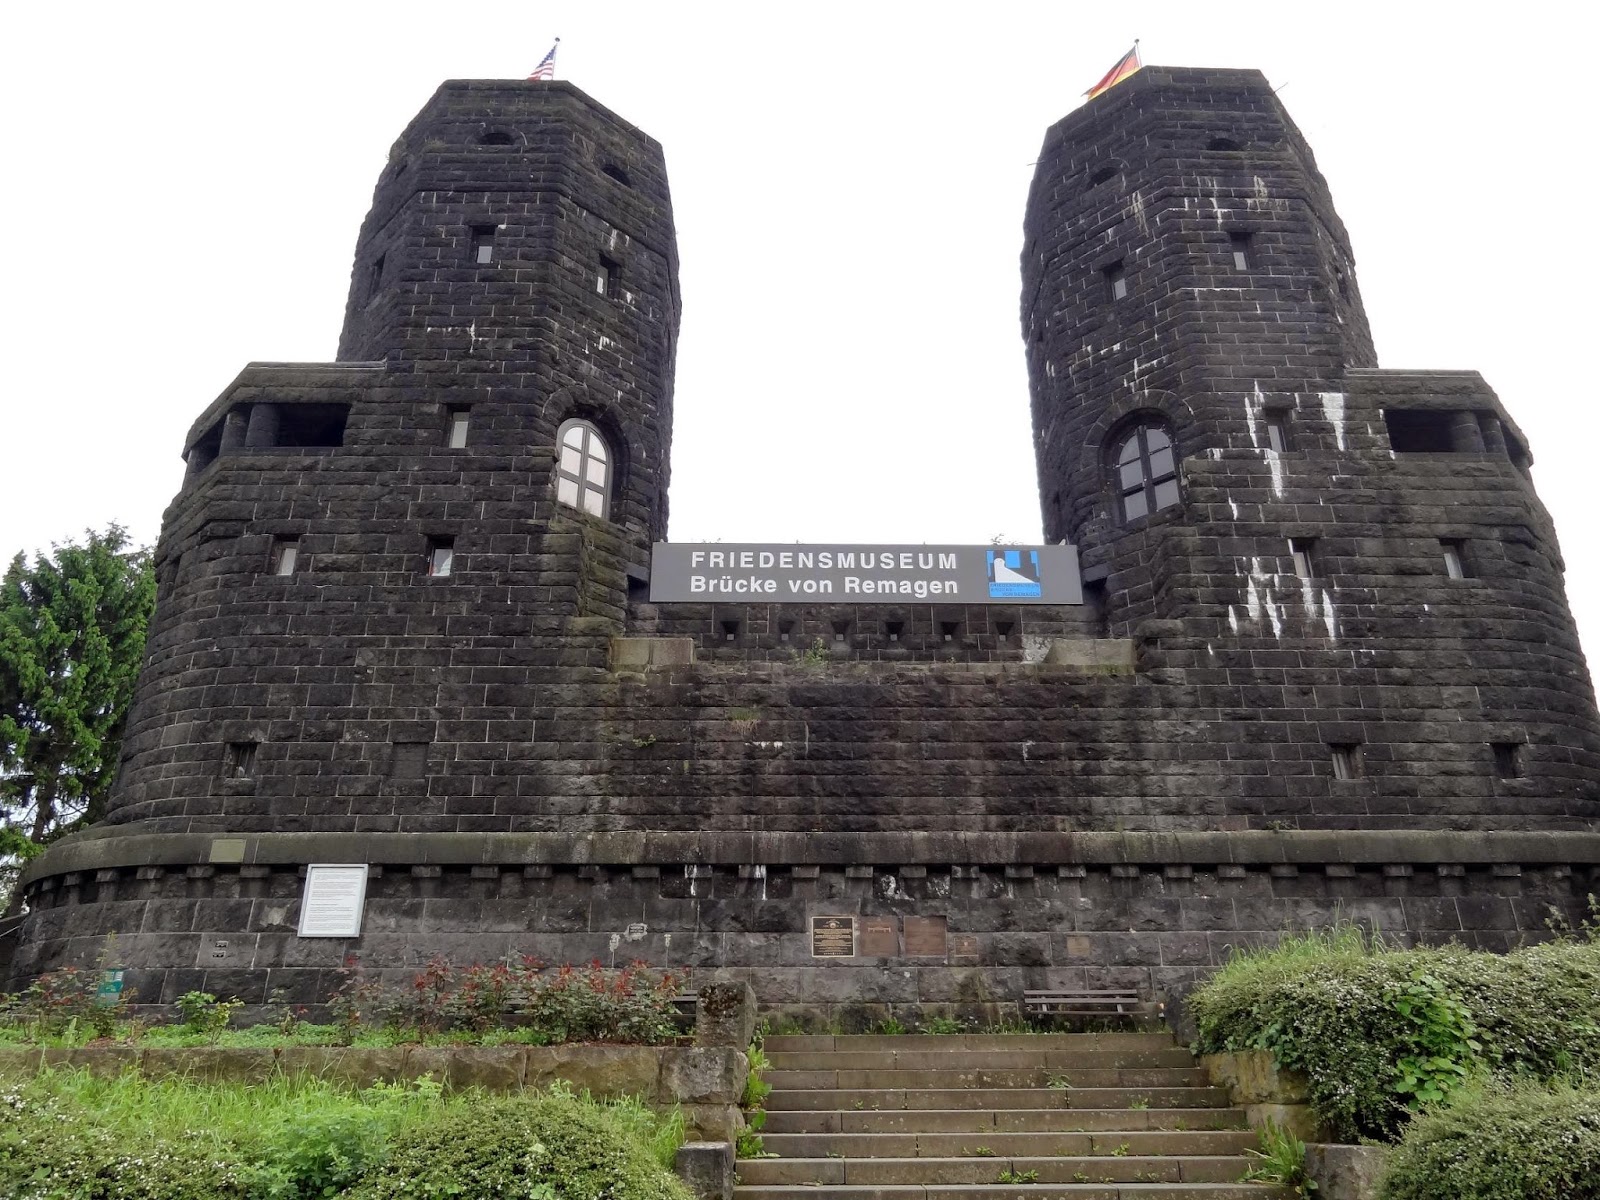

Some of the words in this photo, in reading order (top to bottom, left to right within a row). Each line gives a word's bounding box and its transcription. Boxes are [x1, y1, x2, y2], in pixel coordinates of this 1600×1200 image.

[691, 551, 957, 569] FRIEDENSMUSEUM
[690, 575, 777, 593] Brücke
[788, 579, 833, 593] von
[844, 575, 958, 598] Remagen
